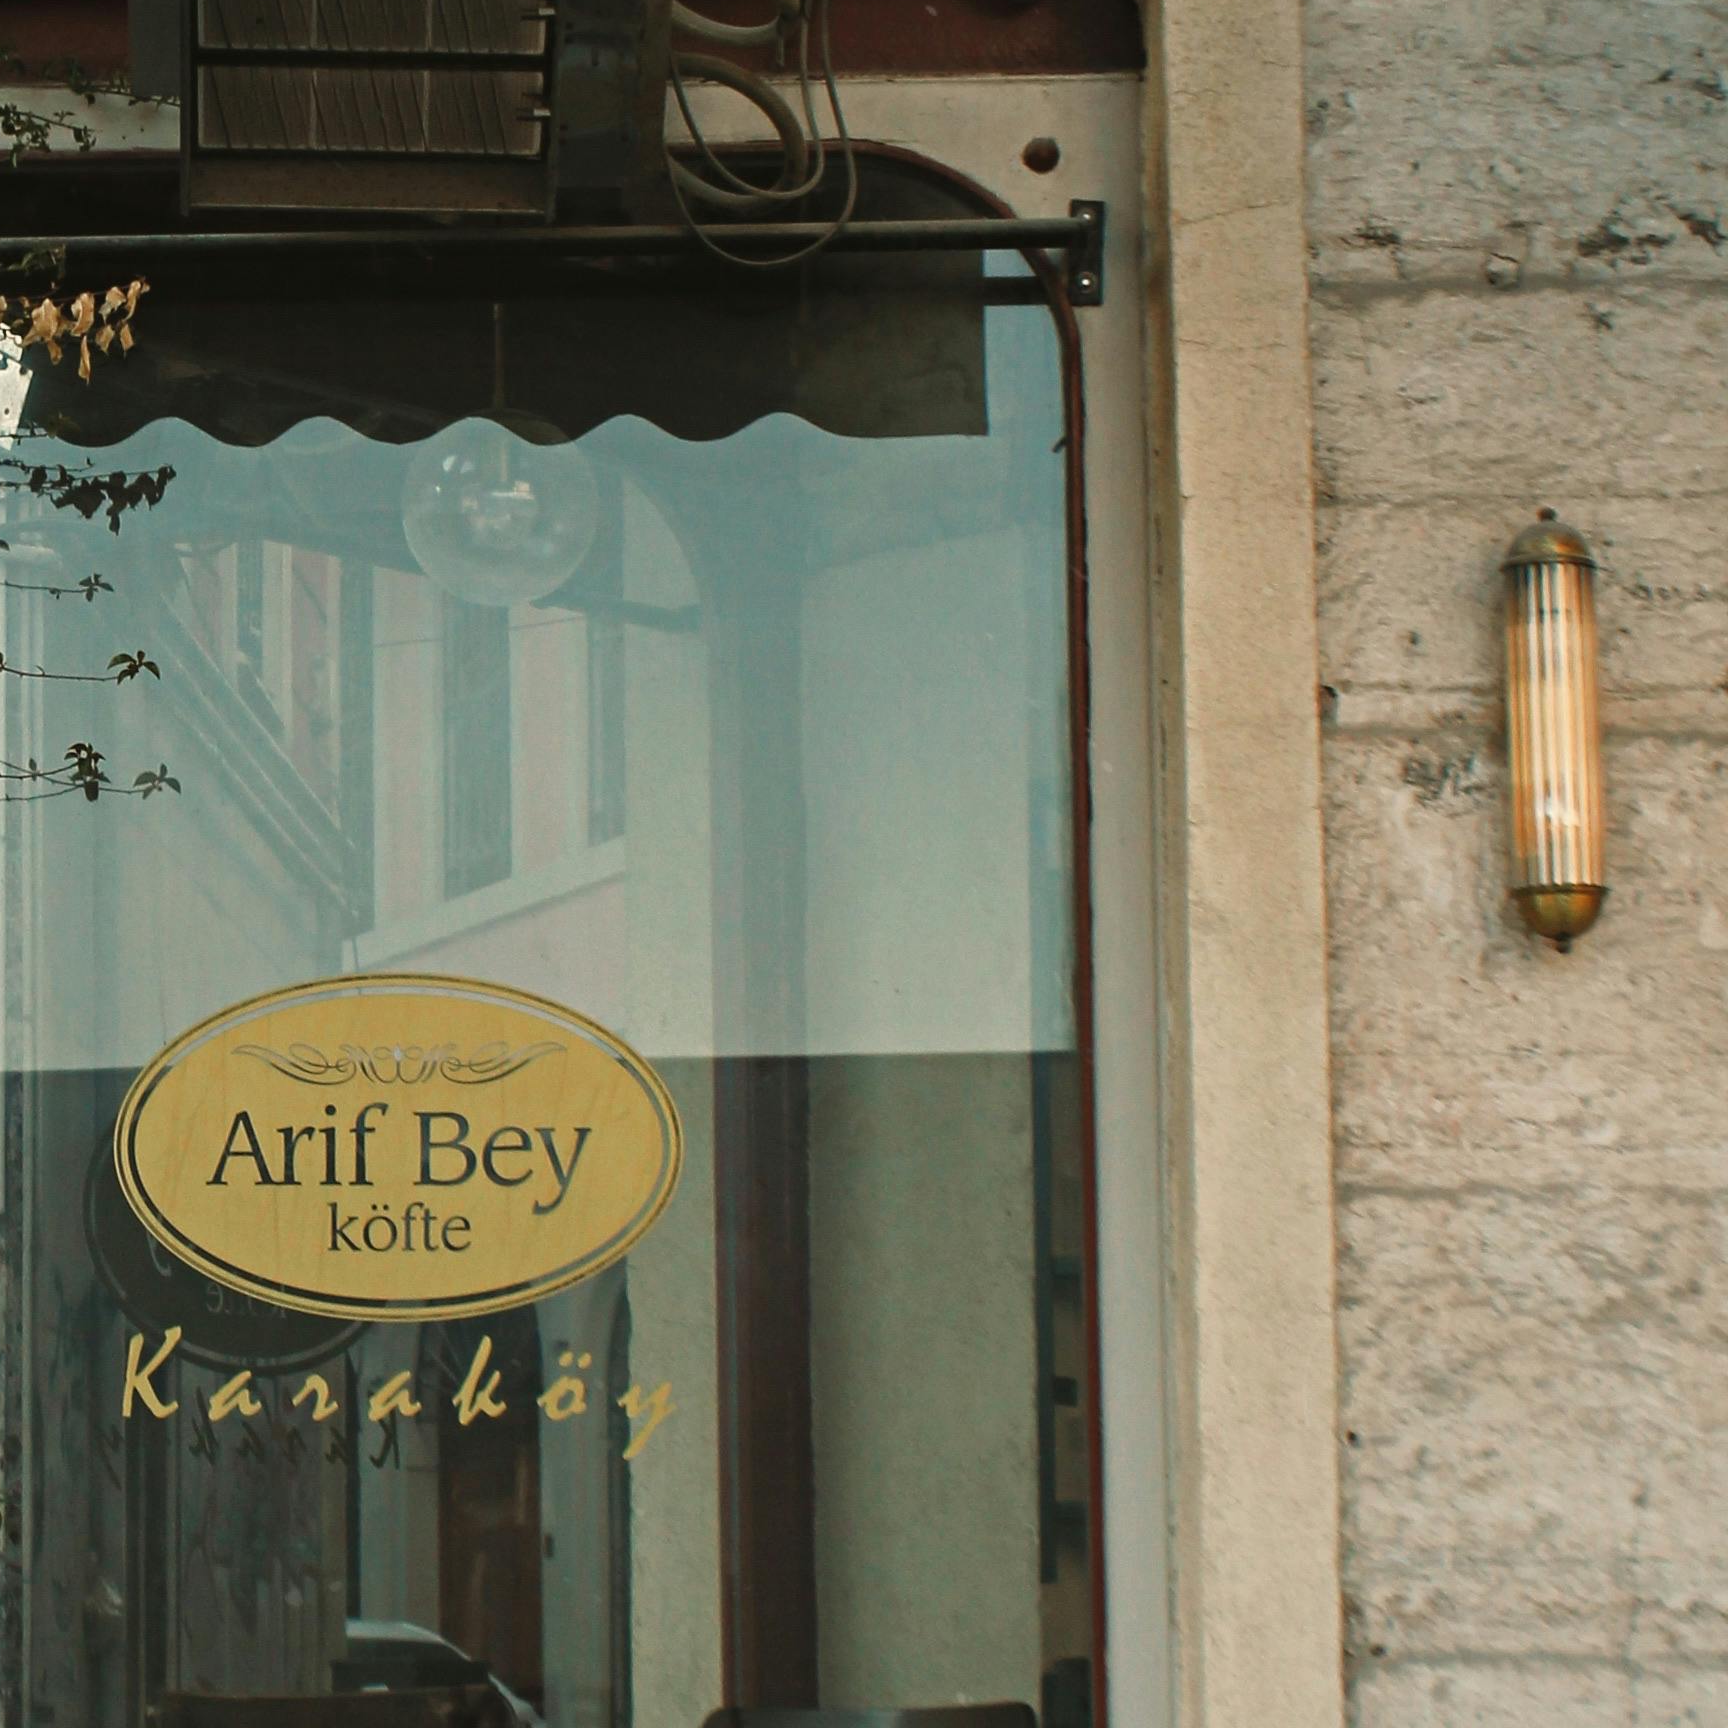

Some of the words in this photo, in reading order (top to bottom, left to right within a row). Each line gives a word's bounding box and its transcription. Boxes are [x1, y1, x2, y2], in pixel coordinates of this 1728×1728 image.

[205, 1101, 390, 1188] Arif
[412, 1110, 593, 1216] Bey
[326, 1201, 472, 1253] köfte
[121, 1325, 676, 1461] Karaköy
